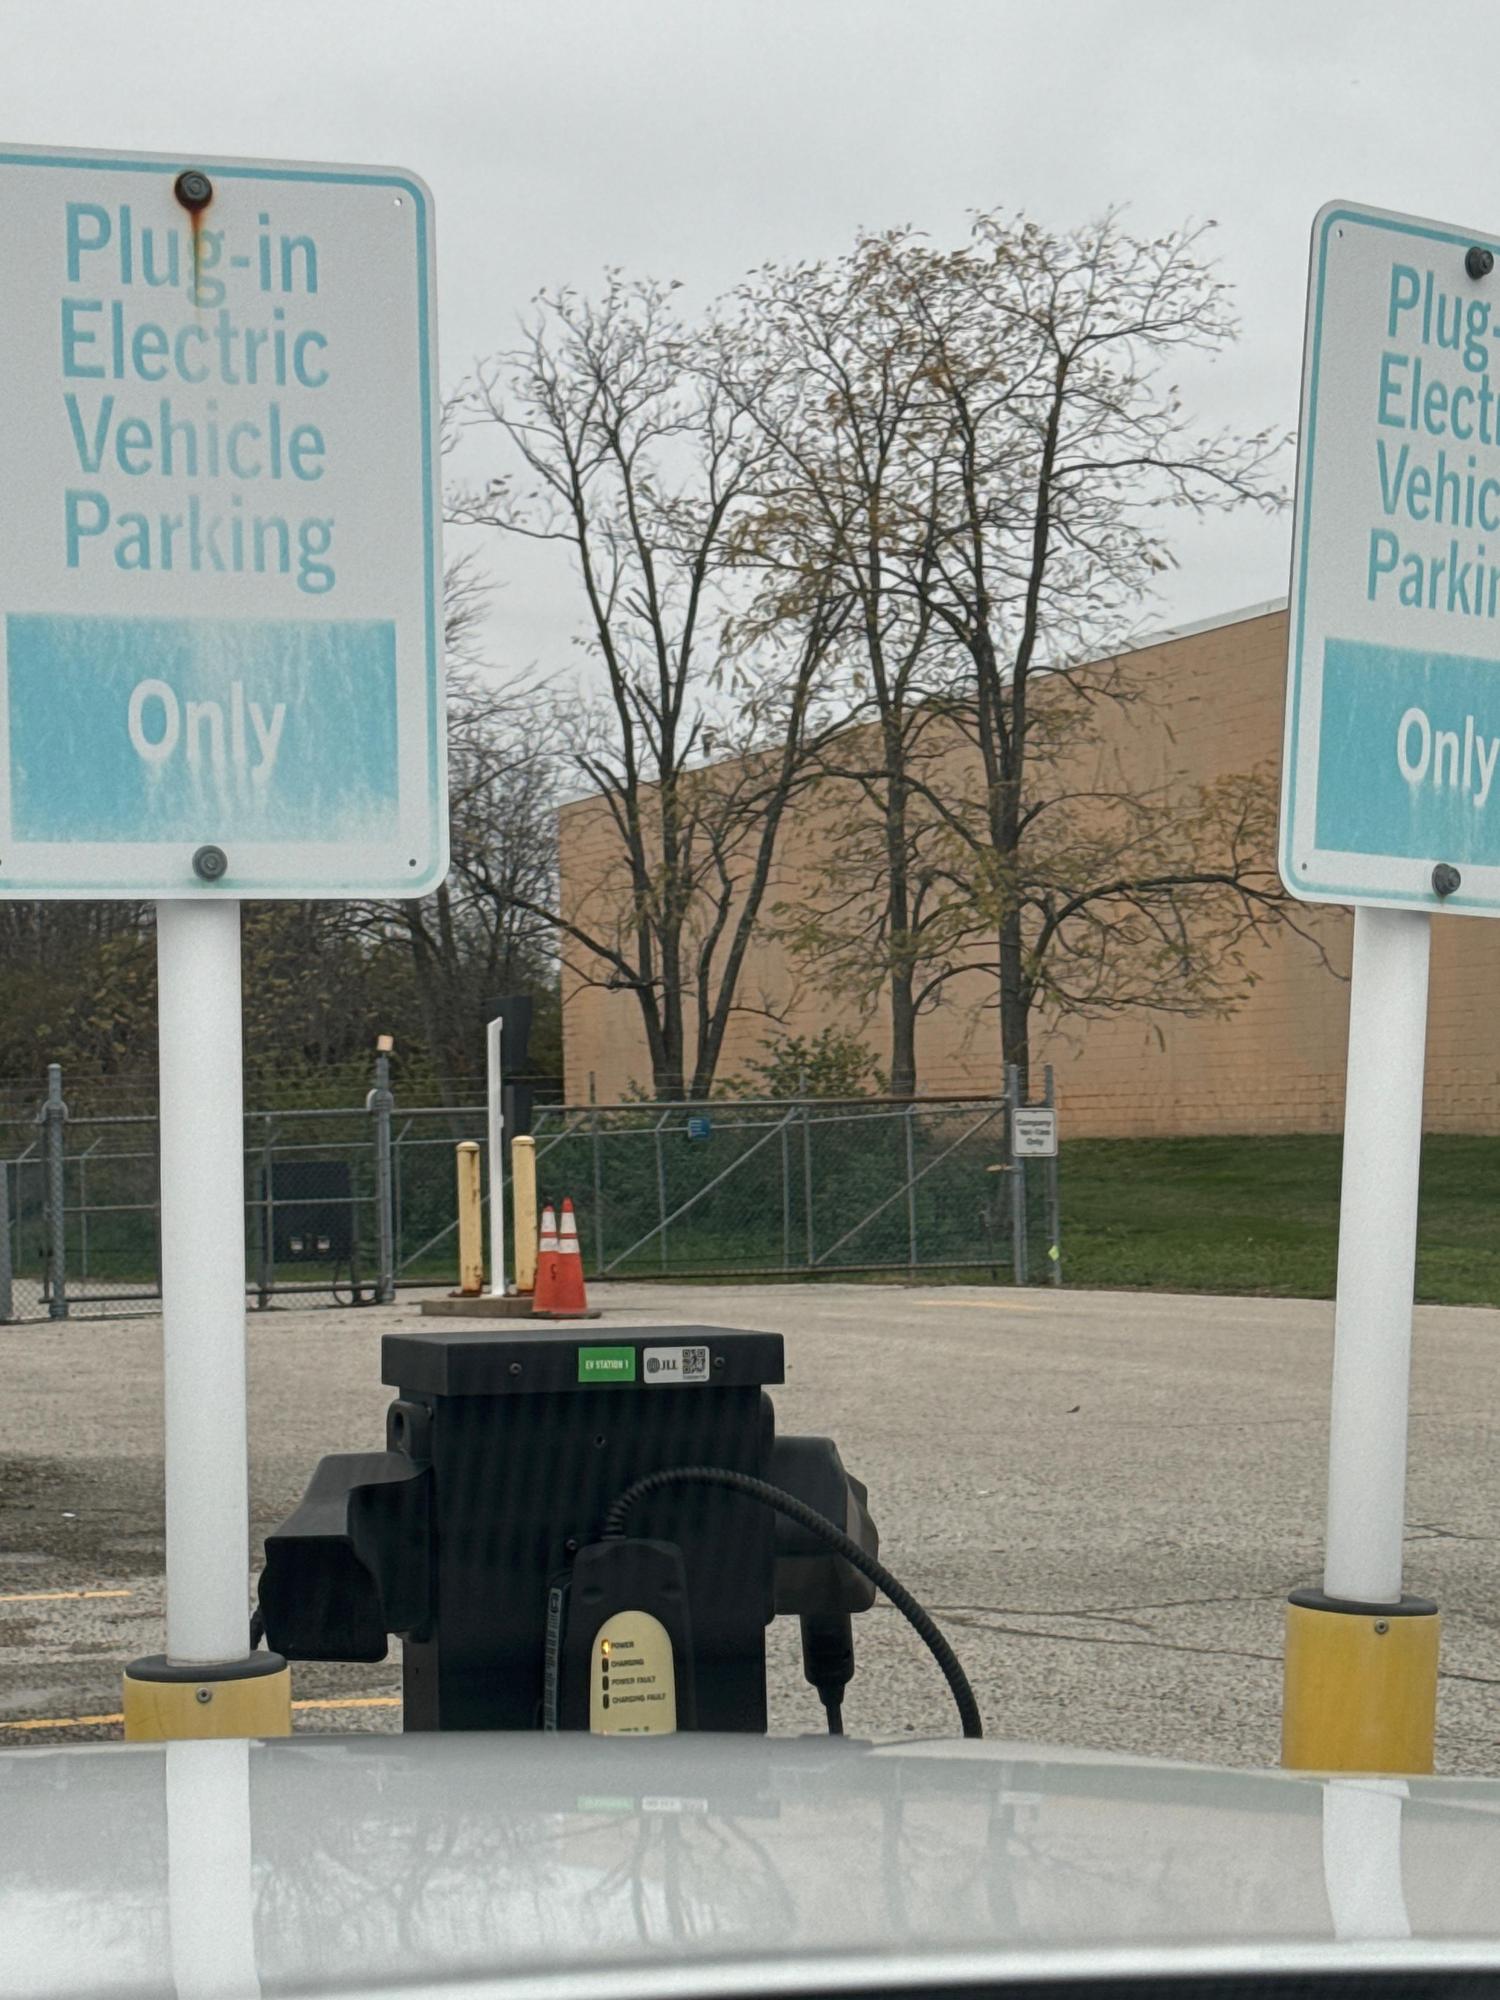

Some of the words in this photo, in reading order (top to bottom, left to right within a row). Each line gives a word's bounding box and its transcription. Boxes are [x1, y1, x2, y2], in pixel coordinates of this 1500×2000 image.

[65, 201, 318, 308] Plug-in
[61, 297, 329, 388] Electric
[63, 392, 326, 481] Vehicle
[1378, 350, 1500, 446] Elect
[1376, 439, 1500, 532] Vehic
[64, 489, 336, 594] Parking
[128, 679, 287, 784] Only
[1397, 707, 1500, 808] Only
[586, 1360, 595, 1370] EV
[596, 1359, 623, 1370] STATION
[611, 1641, 634, 1649] POWER
[611, 1658, 644, 1668] CHARGING
[611, 1677, 635, 1685] POWER
[637, 1675, 656, 1684] FAULT
[612, 1694, 645, 1704] CHARGING
[647, 1692, 666, 1702] FAULT
